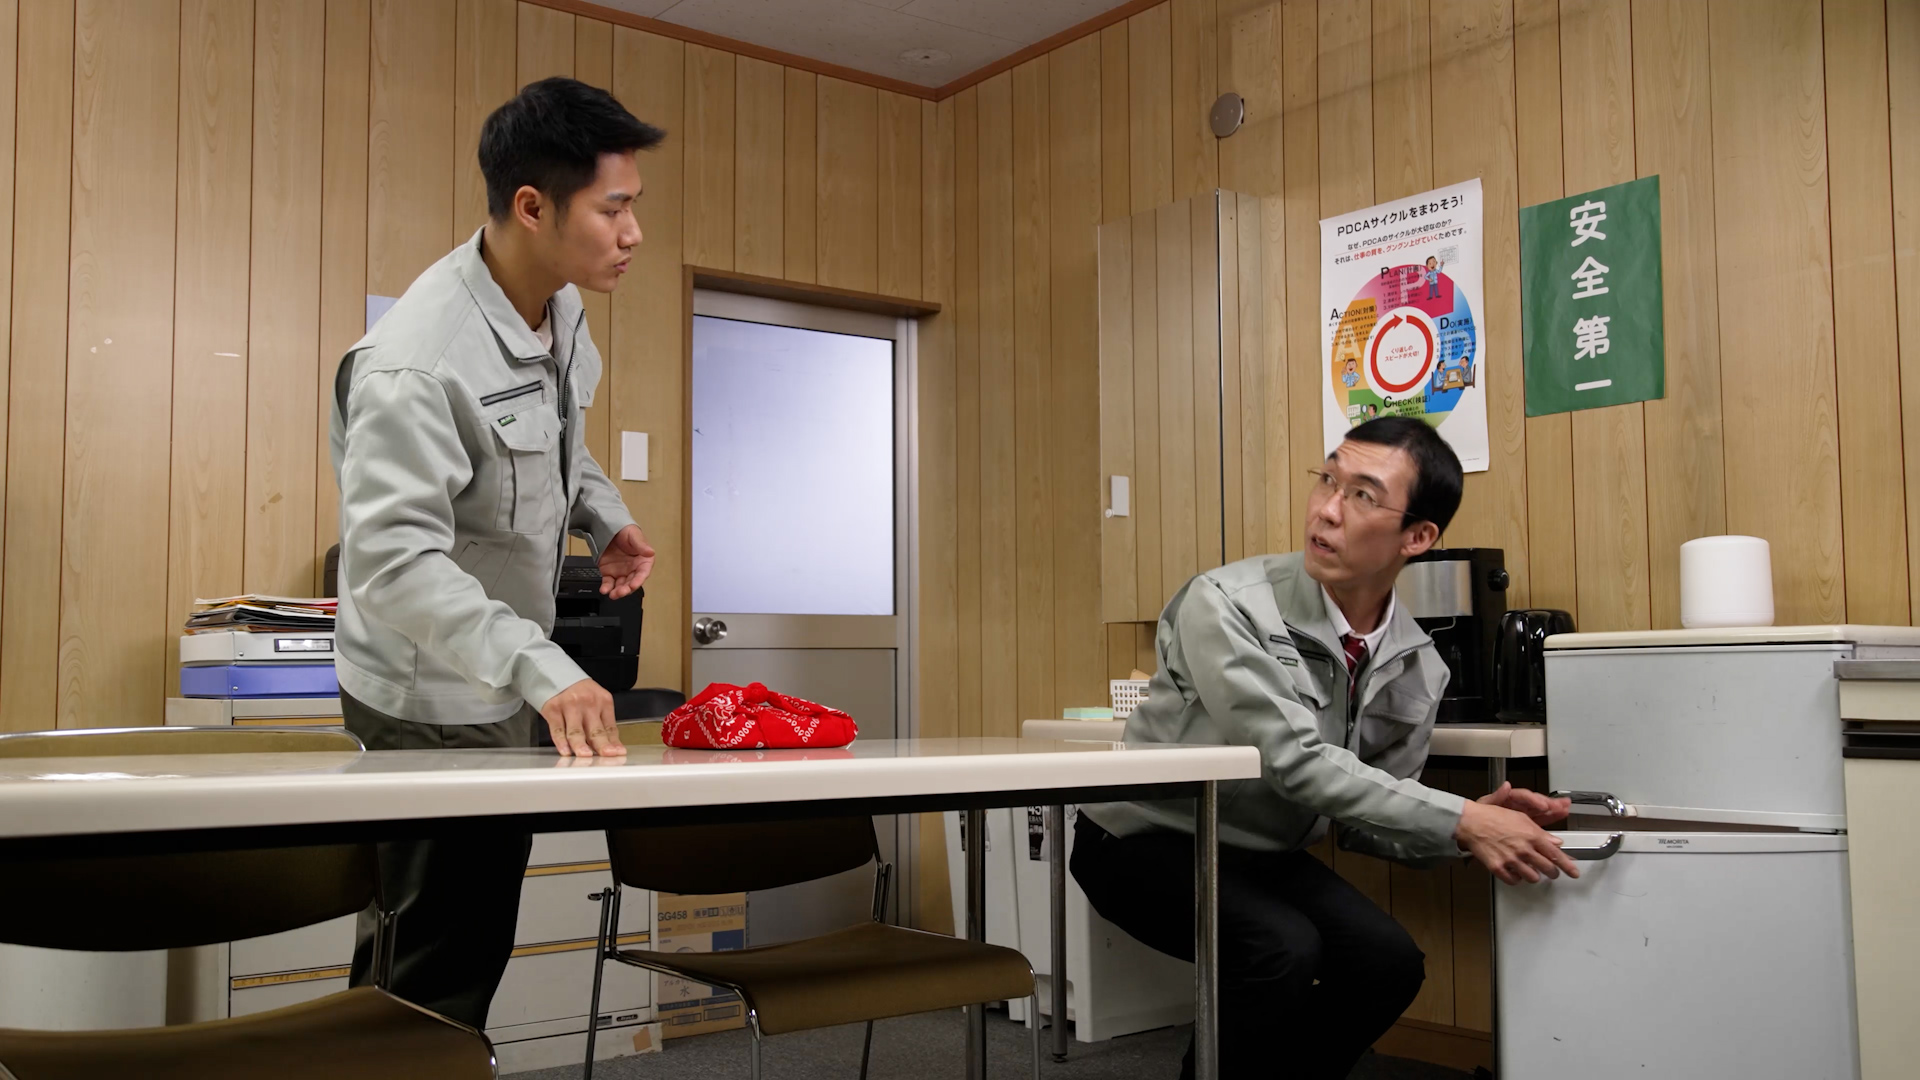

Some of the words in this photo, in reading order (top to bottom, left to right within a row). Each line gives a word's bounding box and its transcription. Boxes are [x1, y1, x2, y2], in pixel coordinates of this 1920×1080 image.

[1337, 195, 1464, 237] PDCAサイクルをまわそう!
[1347, 219, 1453, 251] なぜ、PDCAのサイクルが大切なのか?
[1570, 200, 1612, 391] 安全第一
[657, 910, 688, 921] GG458
